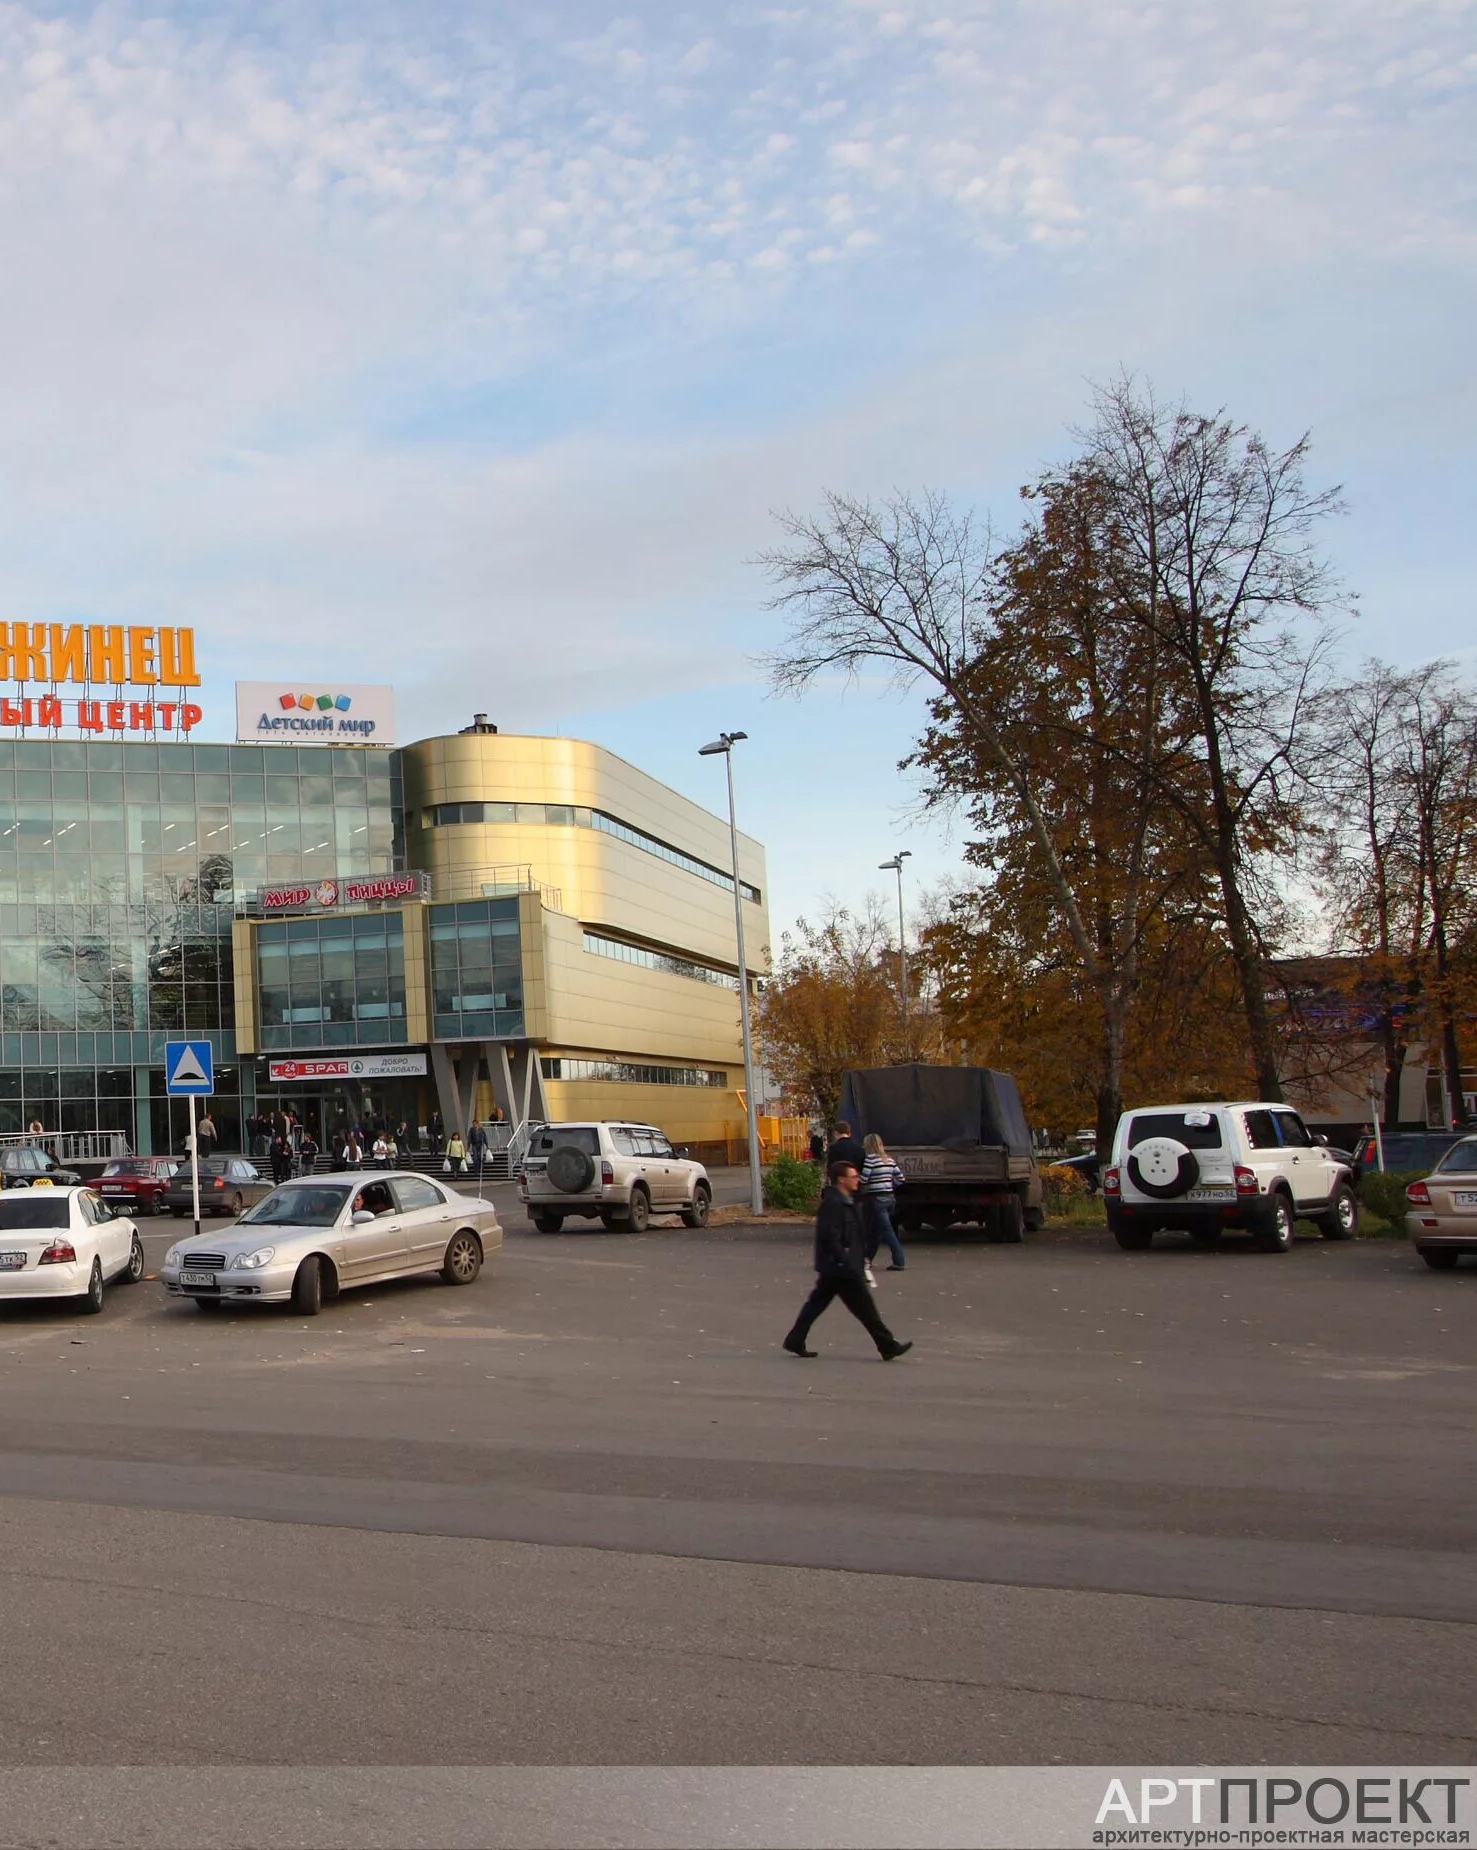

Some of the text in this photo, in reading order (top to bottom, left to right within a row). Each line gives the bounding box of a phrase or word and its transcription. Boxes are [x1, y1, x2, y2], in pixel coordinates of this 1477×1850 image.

[78, 701, 203, 733] ЦЕНТР
[257, 713, 376, 737] Детский мир
[284, 1063, 296, 1072] 24
[381, 1057, 409, 1067] ДОБРО
[305, 1062, 348, 1074] SPAR
[368, 1065, 423, 1075] ПОЖАЛОВАТЬ!
